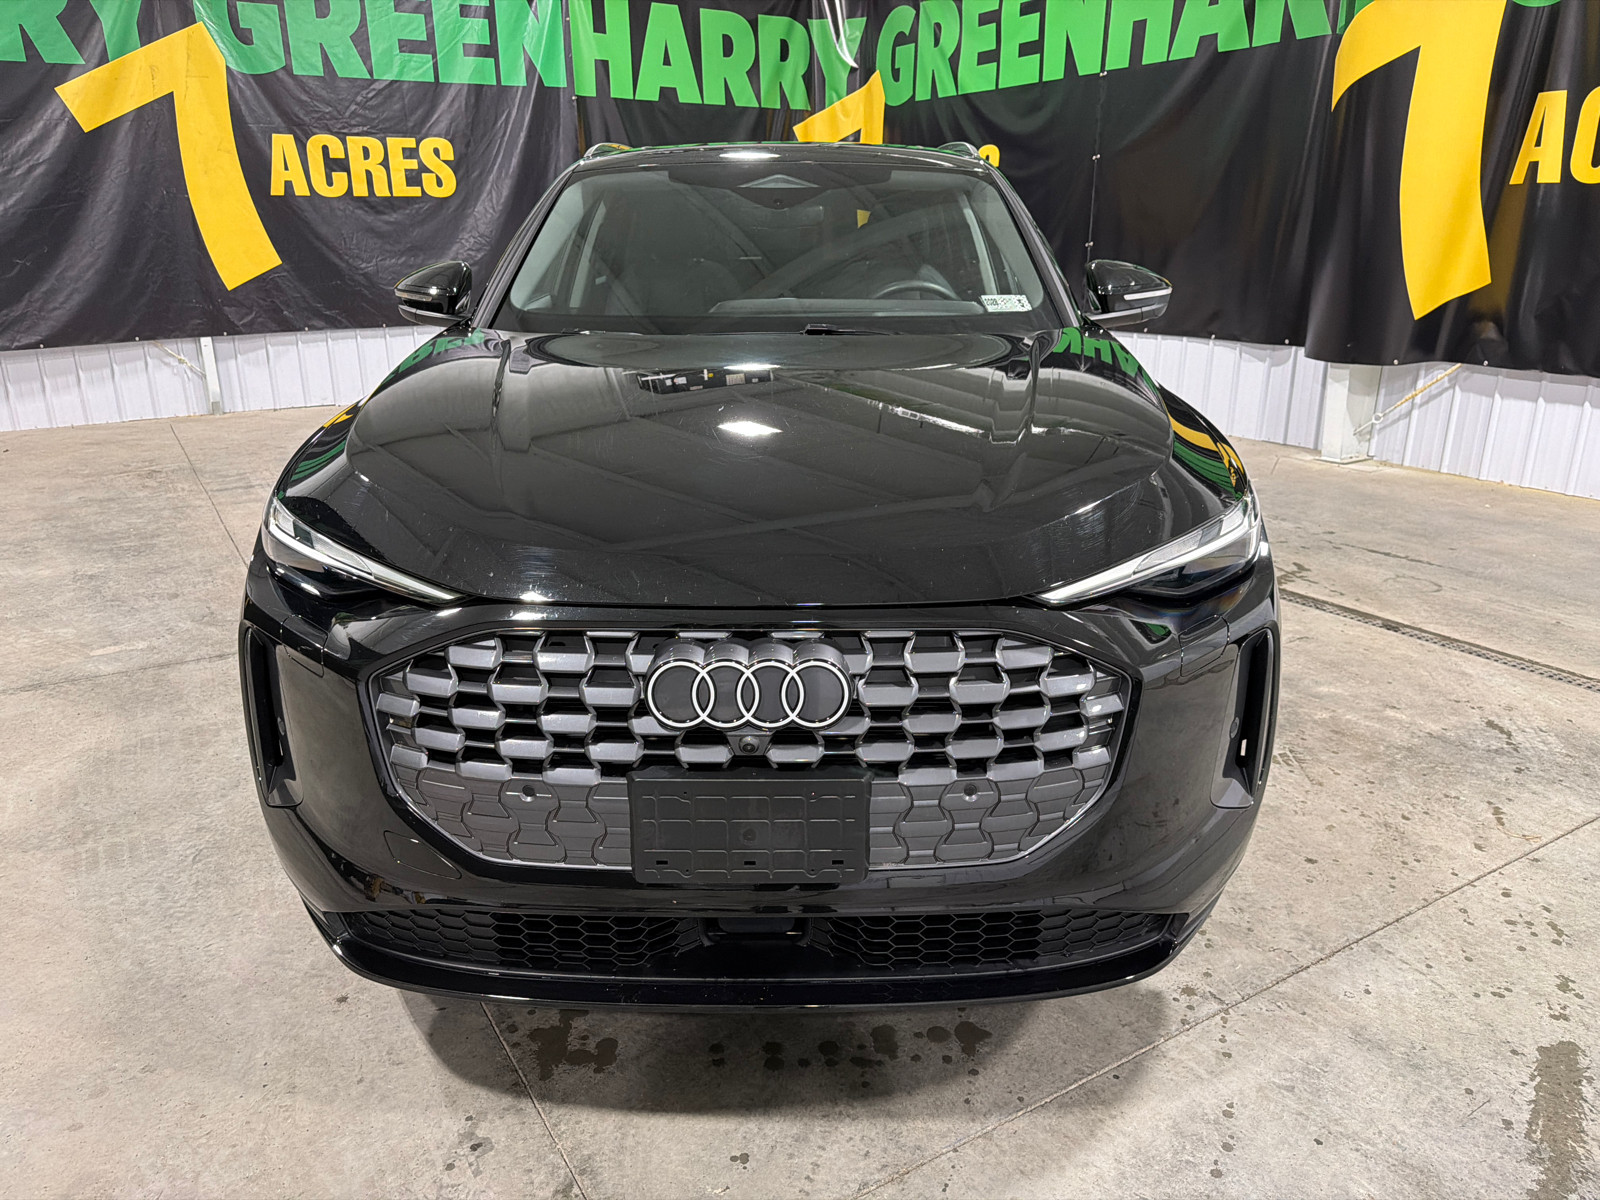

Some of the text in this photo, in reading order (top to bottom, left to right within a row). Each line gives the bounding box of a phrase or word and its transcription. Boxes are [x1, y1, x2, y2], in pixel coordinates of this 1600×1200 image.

[193, 0, 568, 87] GREEN
[568, 0, 868, 111] HARRY
[875, 0, 1107, 107] GREEN
[55, 22, 457, 292] 7 ACRES
